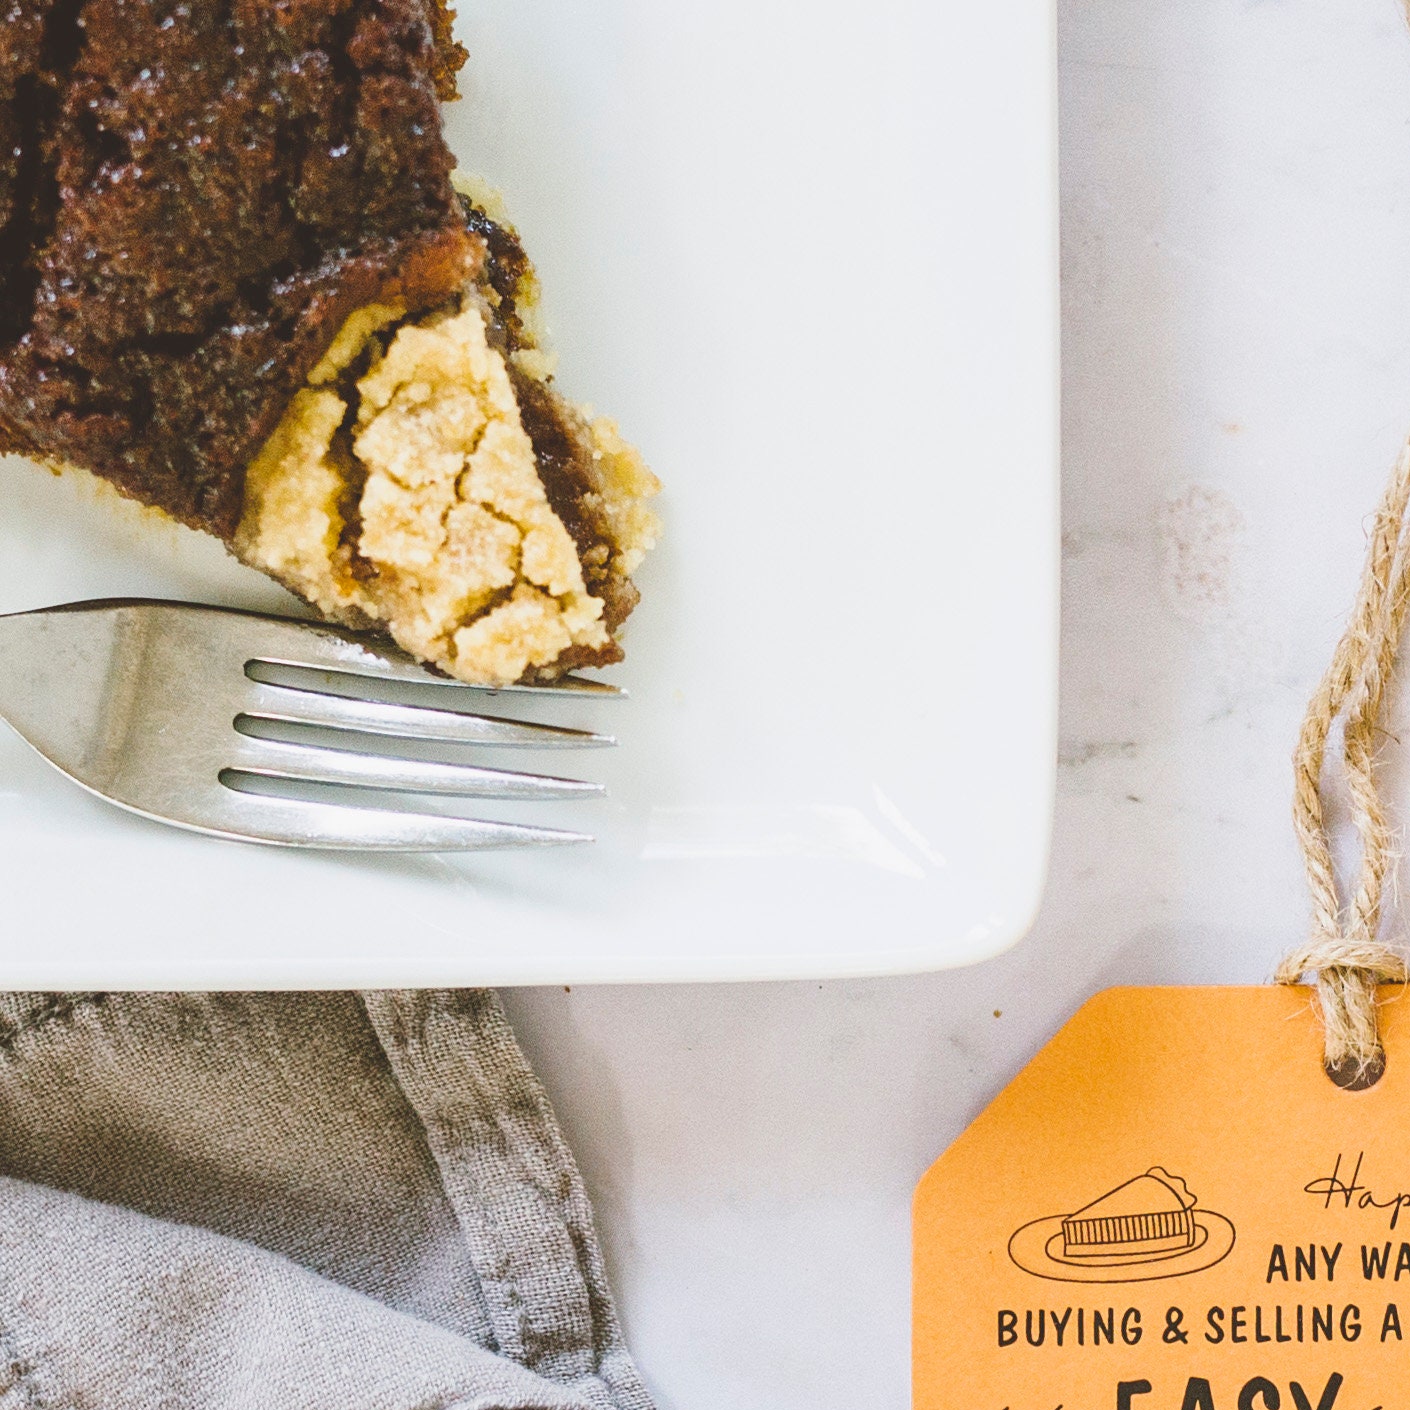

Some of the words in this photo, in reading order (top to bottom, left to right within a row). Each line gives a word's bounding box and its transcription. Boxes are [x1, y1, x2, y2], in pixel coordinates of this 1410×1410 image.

[1266, 1242, 1343, 1284] ANY
[997, 1306, 1143, 1348] BUYING
[1162, 1306, 1189, 1345] &
[1204, 1303, 1362, 1345] SELLING
[1380, 1303, 1403, 1343] A
